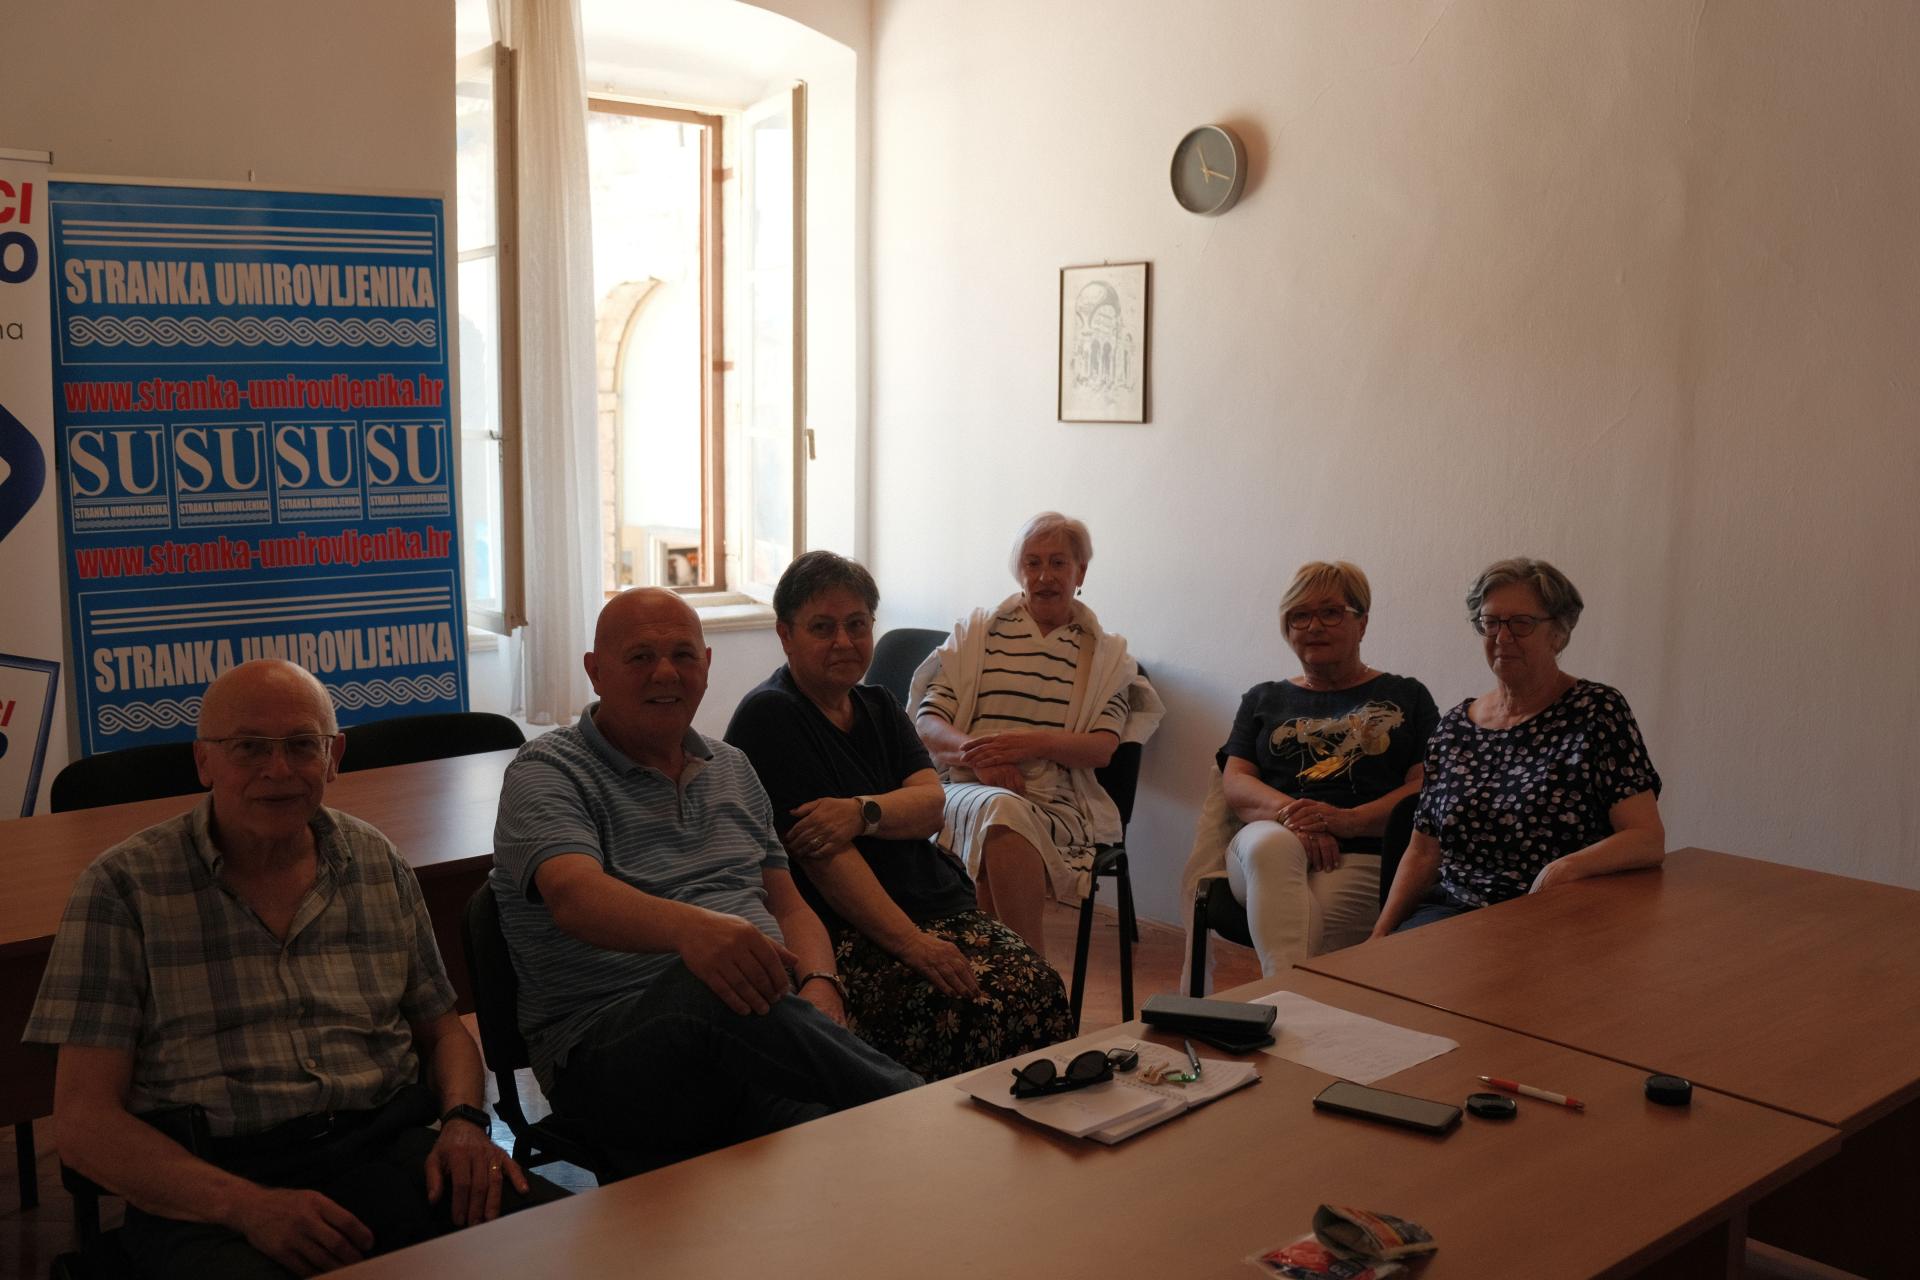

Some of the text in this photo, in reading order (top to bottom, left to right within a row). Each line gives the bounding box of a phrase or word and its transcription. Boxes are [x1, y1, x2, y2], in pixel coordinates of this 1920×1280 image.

[0, 231, 38, 284] O
[64, 257, 436, 308] STRANKA UMIROVLJENIKA
[64, 373, 444, 413] www.stranka-umirovljenika.hr
[70, 423, 445, 497] SU SU SU SU
[75, 506, 110, 520] STRANKA
[179, 502, 213, 515] STRANKA
[75, 525, 452, 579] www.stranka-umirovljenika.hr
[93, 638, 236, 693] STRANKA
